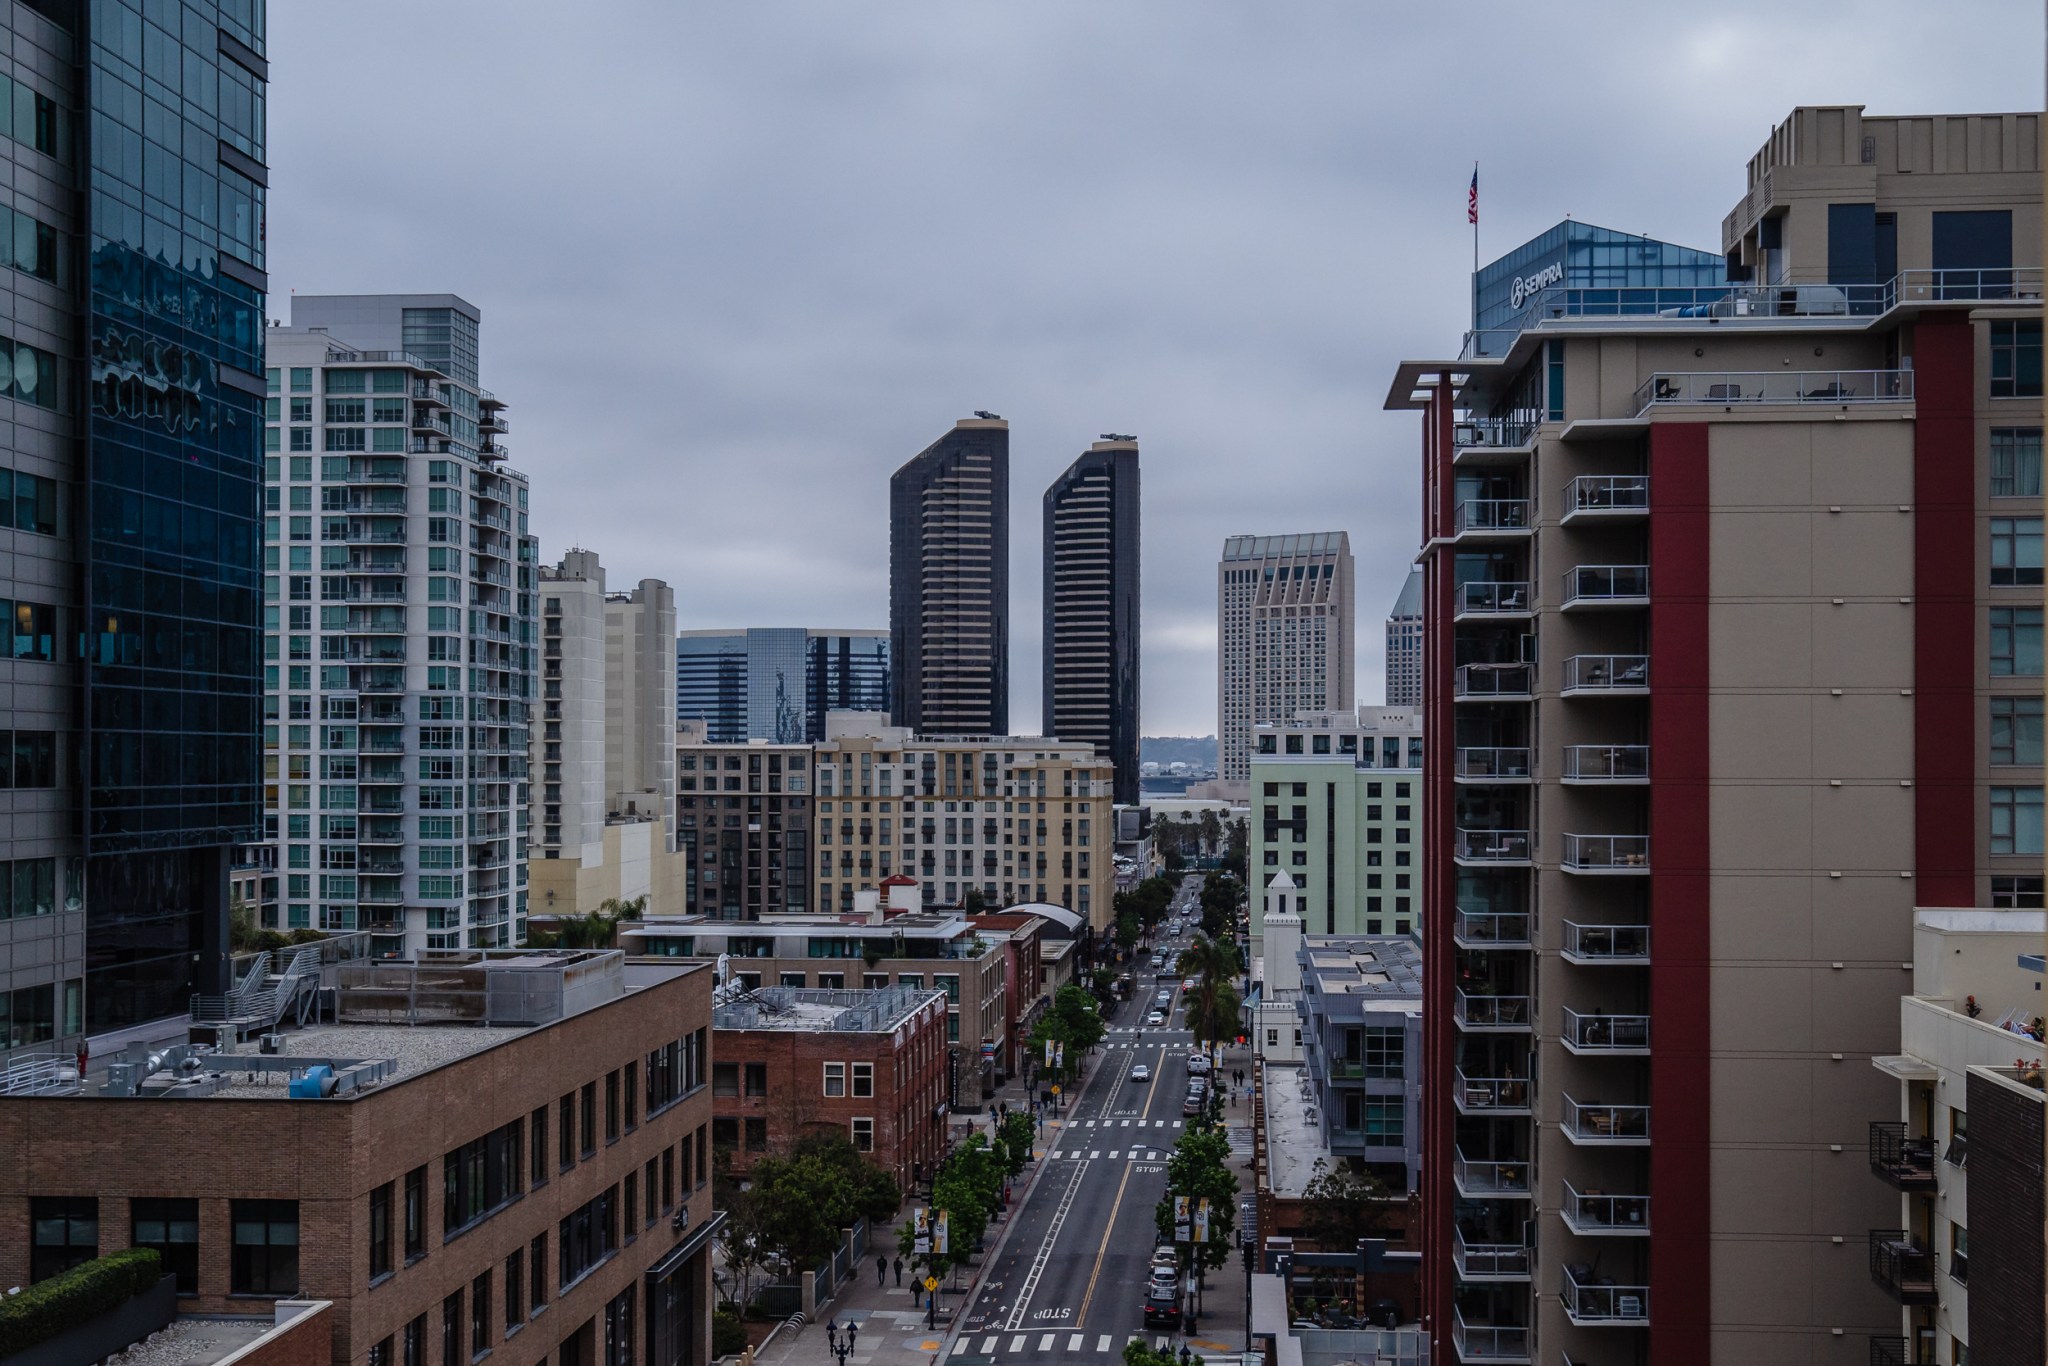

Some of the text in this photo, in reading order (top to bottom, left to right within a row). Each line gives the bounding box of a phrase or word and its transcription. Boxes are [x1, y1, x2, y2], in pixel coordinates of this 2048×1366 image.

[1524, 261, 1563, 297] SEMPRA
[966, 1315, 986, 1323] STOP
[1033, 1307, 1072, 1320] STOP
